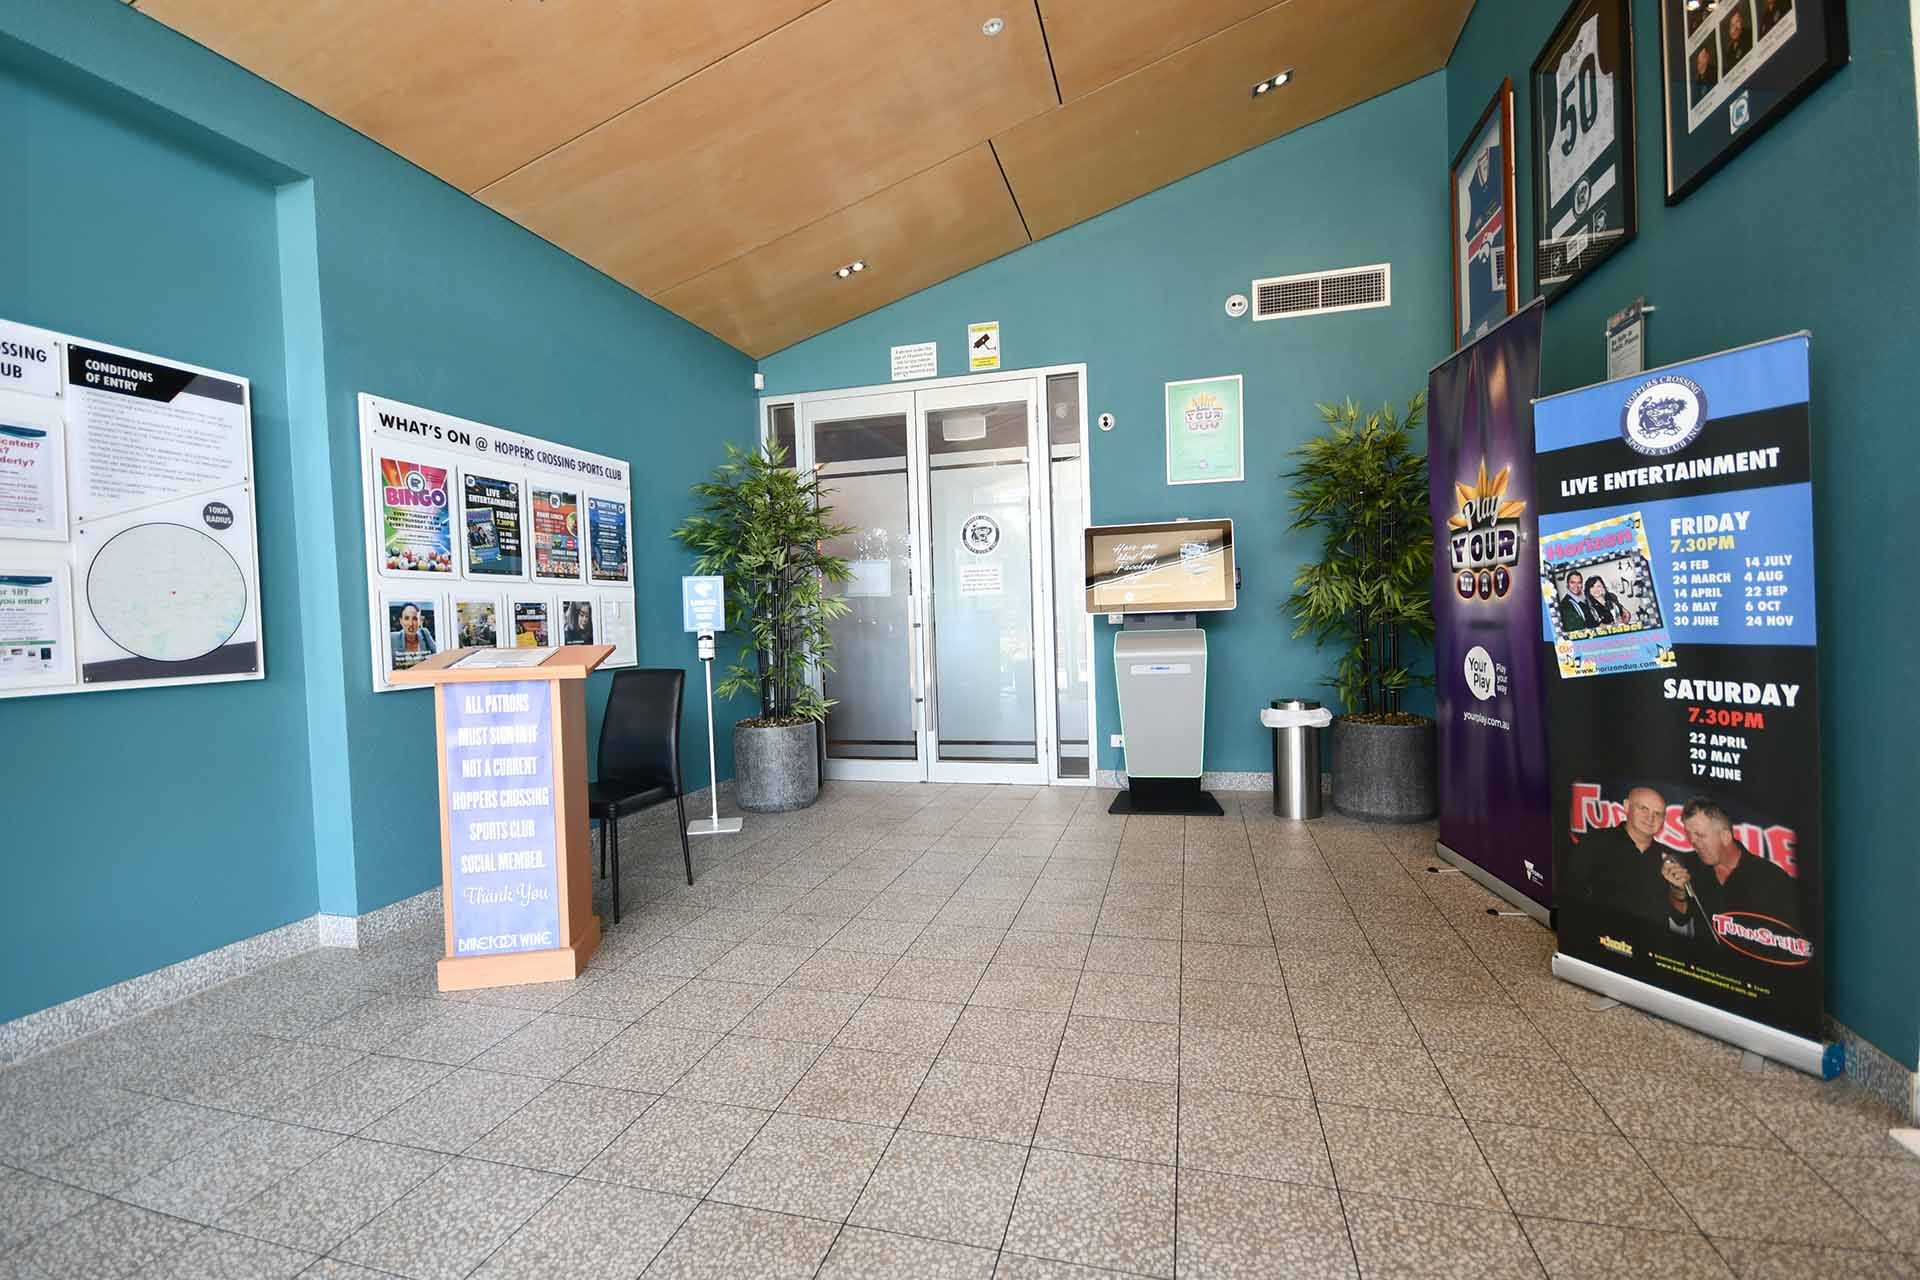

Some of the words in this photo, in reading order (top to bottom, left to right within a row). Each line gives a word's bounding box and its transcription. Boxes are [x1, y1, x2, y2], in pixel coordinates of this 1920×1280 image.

[1560, 53, 1598, 157] 50
[0, 341, 47, 362] SSING
[85, 359, 154, 383] CONDITIONS
[86, 372, 100, 383] OF
[104, 375, 138, 391] ENTRY
[1660, 375, 1702, 394] CROSSING
[379, 412, 442, 440] WHAT'S
[447, 430, 471, 446] ON
[475, 436, 488, 451] @
[494, 440, 535, 461] HOPPERS
[536, 451, 576, 470] CROSSING
[578, 461, 604, 476] SPORTS
[605, 467, 622, 481] CLUB
[1625, 436, 1657, 455] SPORTS
[1561, 475, 1598, 497] LIVE
[1604, 447, 1780, 491] ENTERTAINMENT
[384, 486, 446, 508] BINGO
[485, 488, 500, 498] LIVE
[1462, 496, 1504, 531] Play
[1670, 511, 1750, 537] FRIDAY
[1452, 529, 1515, 563] YOUR
[1546, 529, 1633, 561] Horizon
[1670, 535, 1736, 553] 7.30PM
[1672, 561, 1687, 571] 24
[1690, 560, 1709, 570] FEB
[1745, 556, 1760, 567] 14
[1764, 554, 1793, 567] JULY
[1460, 573, 1504, 593] WAY
[1673, 574, 1687, 585] 24
[1691, 573, 1731, 584] MARCH
[1744, 572, 1752, 582] 4
[1757, 570, 1784, 582] AUG
[1674, 588, 1687, 598] 14
[1691, 588, 1723, 598] APRIL
[1745, 586, 1763, 597] 22
[1765, 585, 1788, 597] SEP
[1673, 602, 1688, 612] 26
[1692, 602, 1718, 612] MAY
[1745, 601, 1753, 611] 6
[1757, 600, 1782, 611] OCT
[1674, 616, 1689, 626] 30
[1692, 615, 1719, 626] JUNE
[1745, 616, 1763, 626] 24
[1766, 615, 1794, 626] NOV
[1468, 657, 1487, 673] Your
[1473, 673, 1491, 693] Play
[1663, 678, 1800, 707] SATURDAY
[464, 695, 484, 714] ALL
[486, 694, 530, 713] PATRONS
[1687, 707, 1765, 729] 7.30PM
[458, 727, 487, 746] MUST
[1689, 732, 1706, 744] 22
[1710, 734, 1748, 750] APRIL
[1690, 748, 1706, 760] 20
[1710, 750, 1741, 765] MAY
[462, 759, 482, 778] NOT
[484, 758, 492, 776] A
[494, 757, 537, 776] CURRENT
[1691, 763, 1706, 775] 17
[1710, 765, 1742, 782] JUNE
[453, 790, 498, 810] HOPPERS
[500, 787, 549, 807] CROSSING
[470, 821, 507, 841] SPORTS
[510, 820, 535, 838] CLUB
[461, 853, 497, 873] SOCIAL
[463, 884, 513, 904] Thank
[516, 882, 551, 907] You
